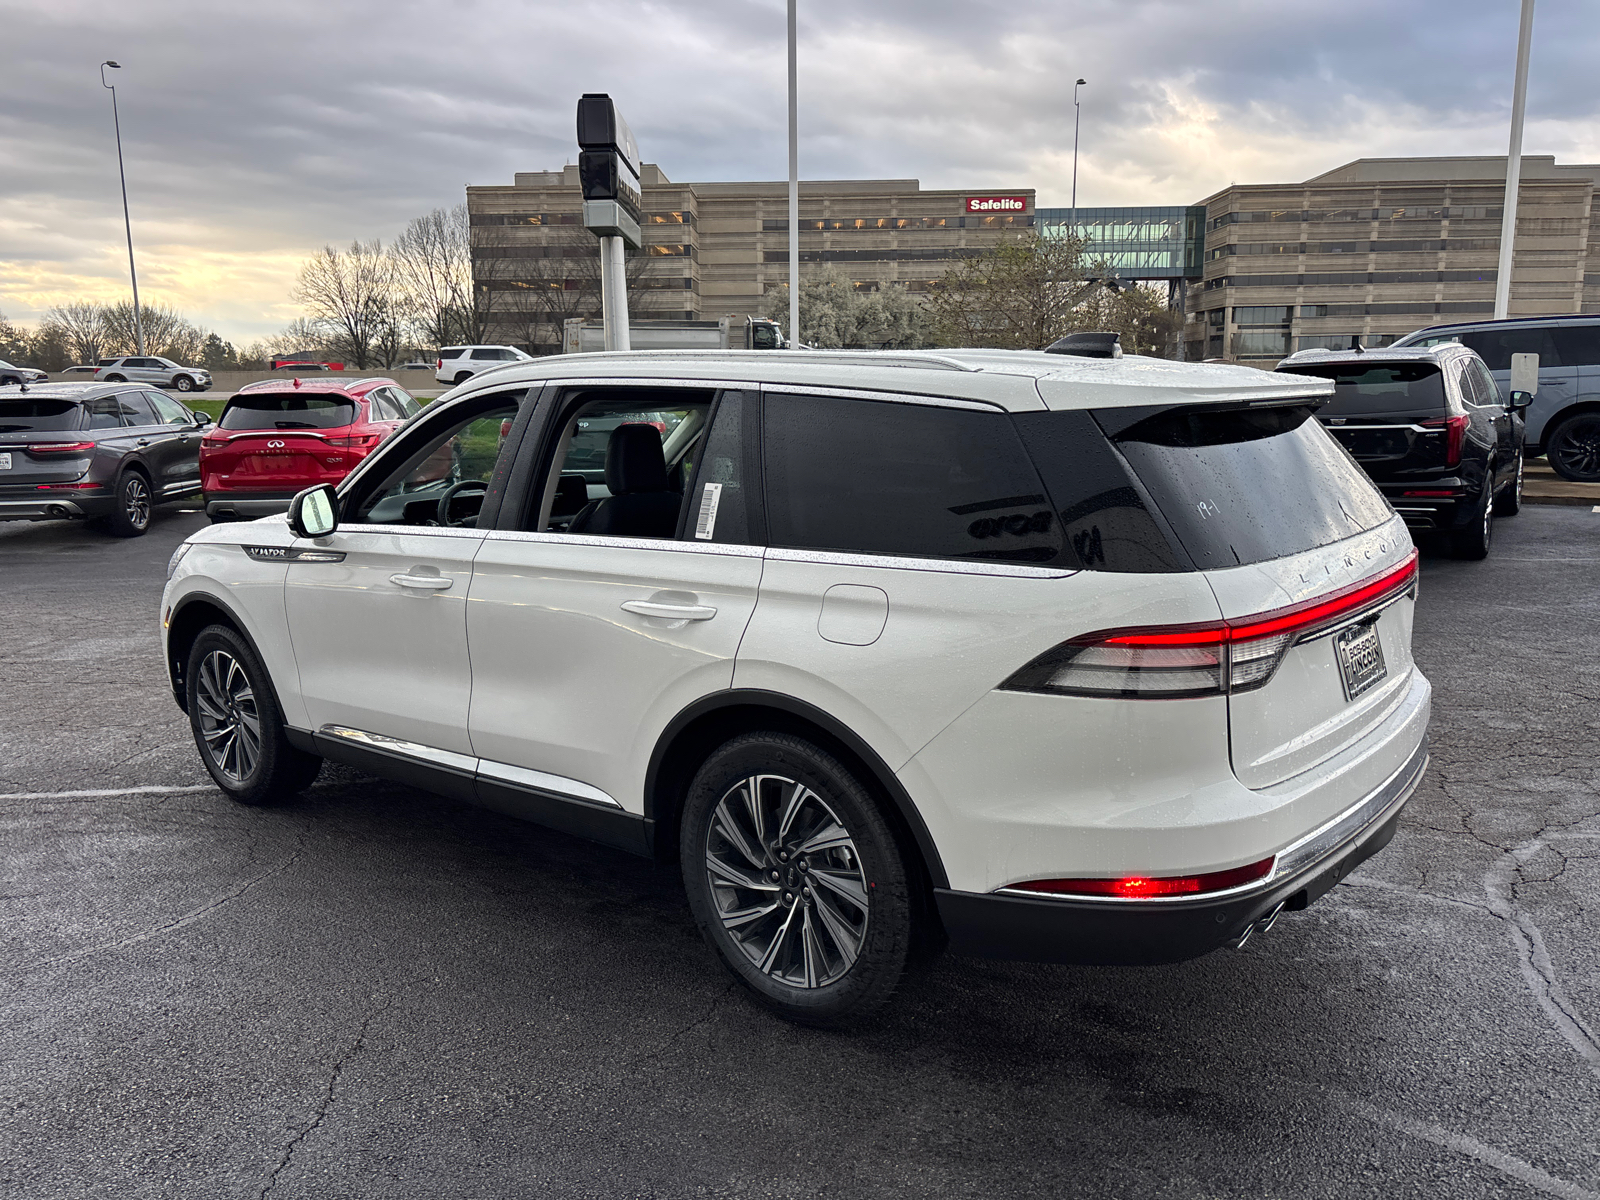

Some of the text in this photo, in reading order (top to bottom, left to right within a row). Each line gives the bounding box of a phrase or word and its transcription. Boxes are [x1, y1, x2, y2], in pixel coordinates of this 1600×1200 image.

[970, 198, 1023, 210] Safelite
[250, 547, 286, 557] AVIATOR
[1299, 533, 1407, 584] LINCOLN
